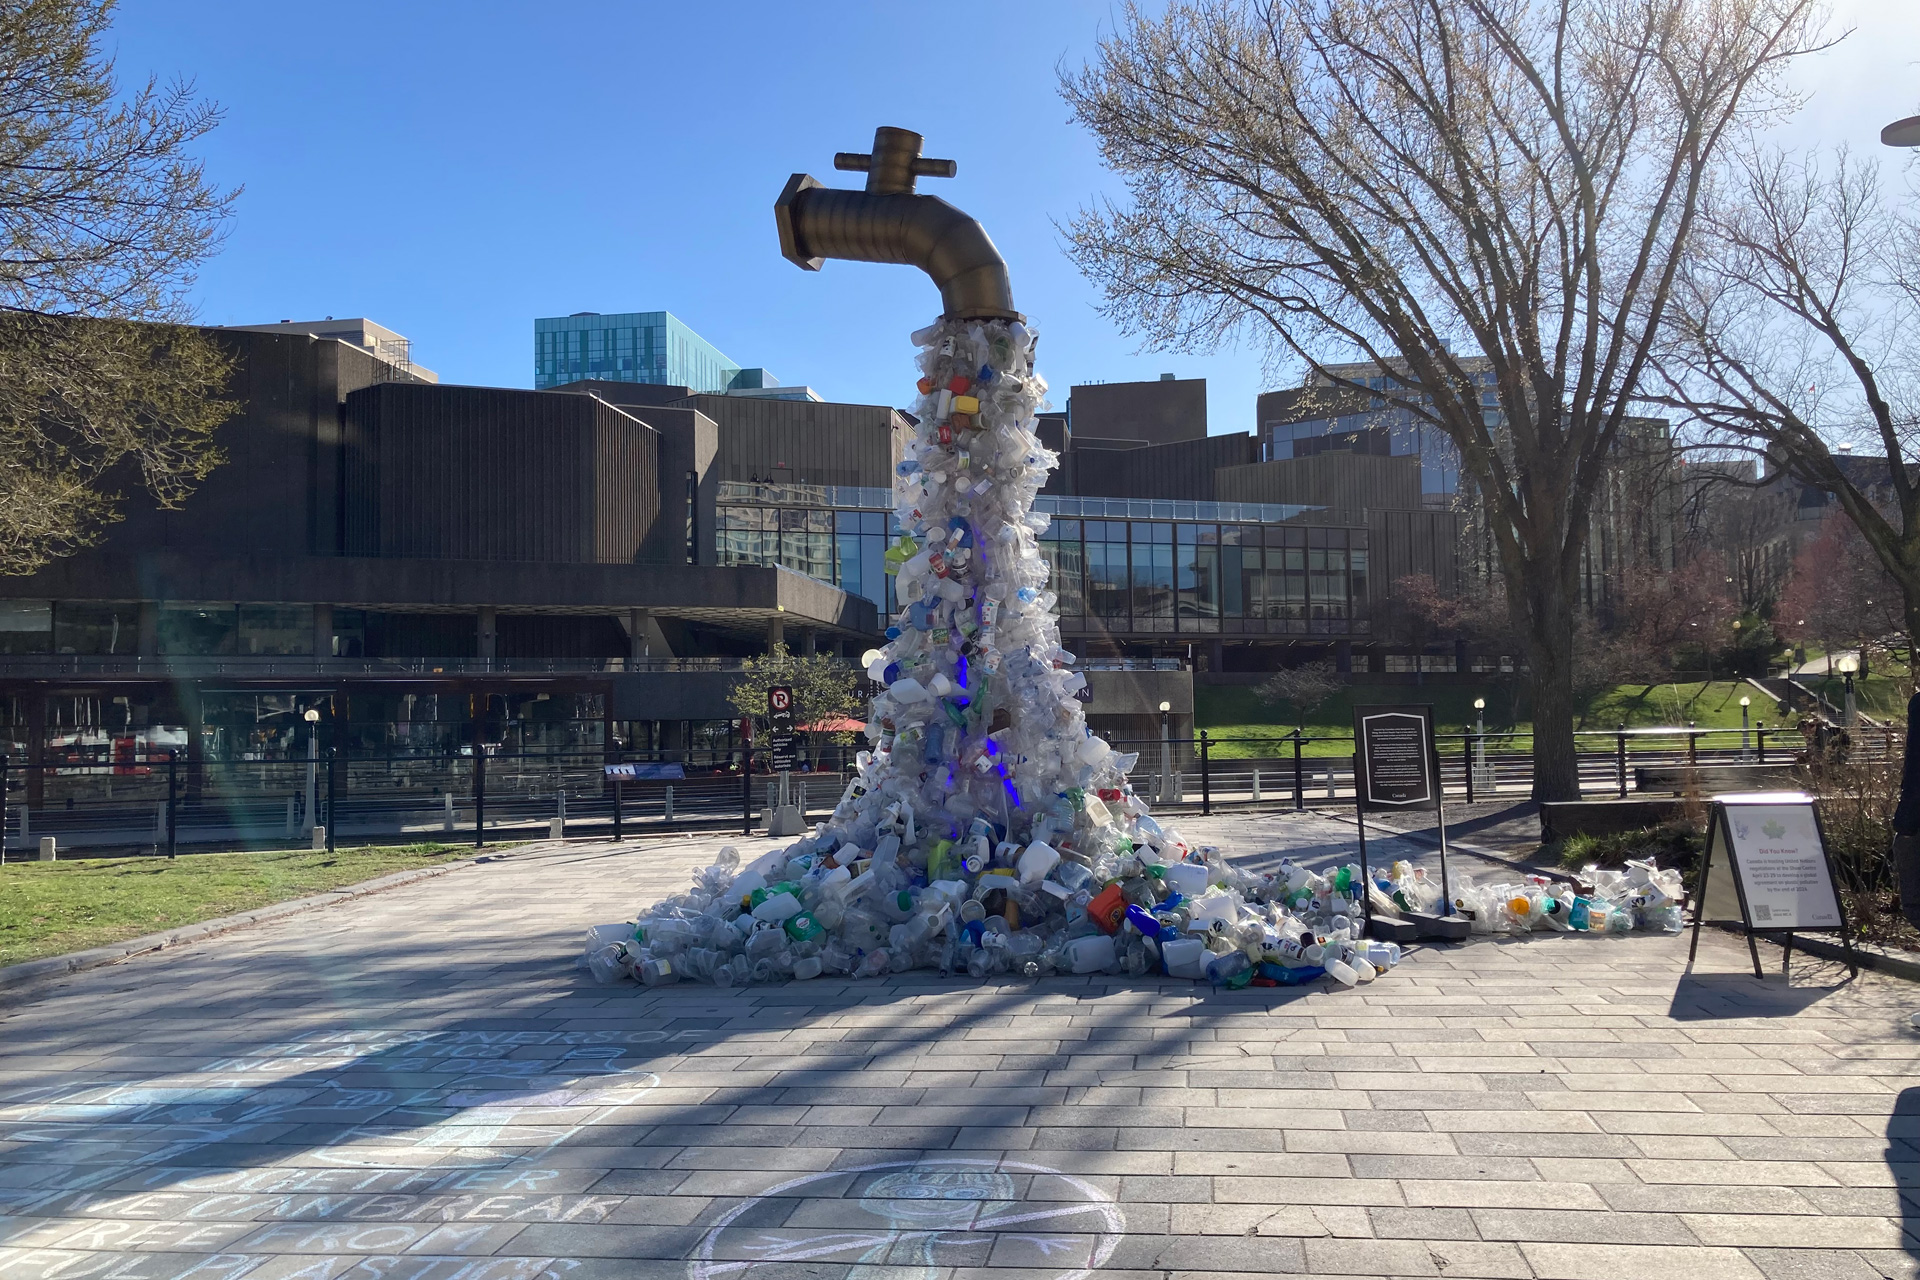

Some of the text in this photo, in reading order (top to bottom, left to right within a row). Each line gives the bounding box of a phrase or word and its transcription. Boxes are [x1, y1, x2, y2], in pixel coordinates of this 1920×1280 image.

[624, 1029, 711, 1044] OF
[246, 1043, 519, 1058] PLASTICS
[143, 1168, 560, 1193] TOGETHER
[64, 1192, 625, 1222] WE CAN BREAK
[3, 1218, 494, 1251] FREE FROM
[169, 1253, 582, 1280] PLASTICS
